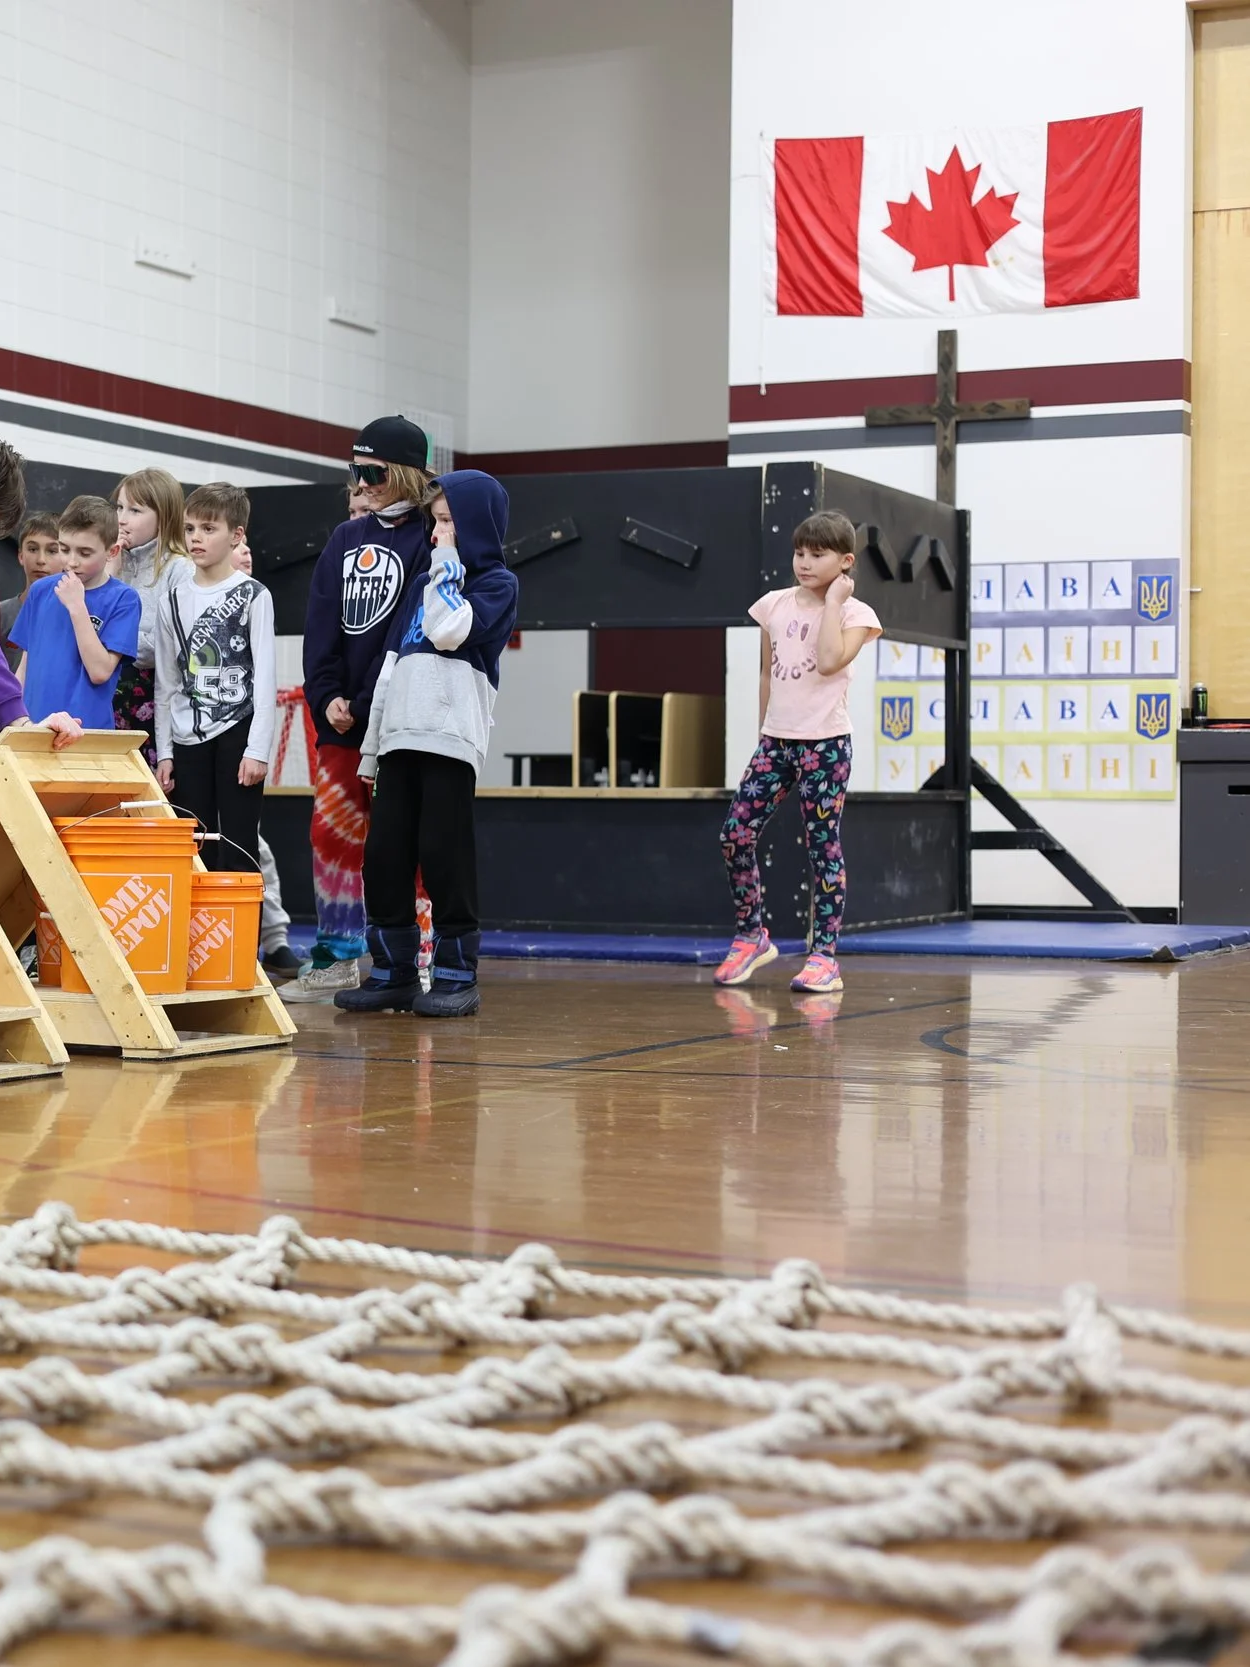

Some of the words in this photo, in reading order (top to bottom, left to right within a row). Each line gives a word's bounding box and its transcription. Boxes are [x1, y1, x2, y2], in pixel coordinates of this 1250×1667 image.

[973, 576, 1122, 600] ЛАВА
[190, 621, 214, 655] NEW
[211, 590, 247, 622] YORK
[194, 665, 248, 707] 59
[888, 753, 1157, 780] УАЇНІ
[99, 875, 153, 931] OME
[114, 888, 170, 957] EPOT
[190, 908, 218, 943] ME
